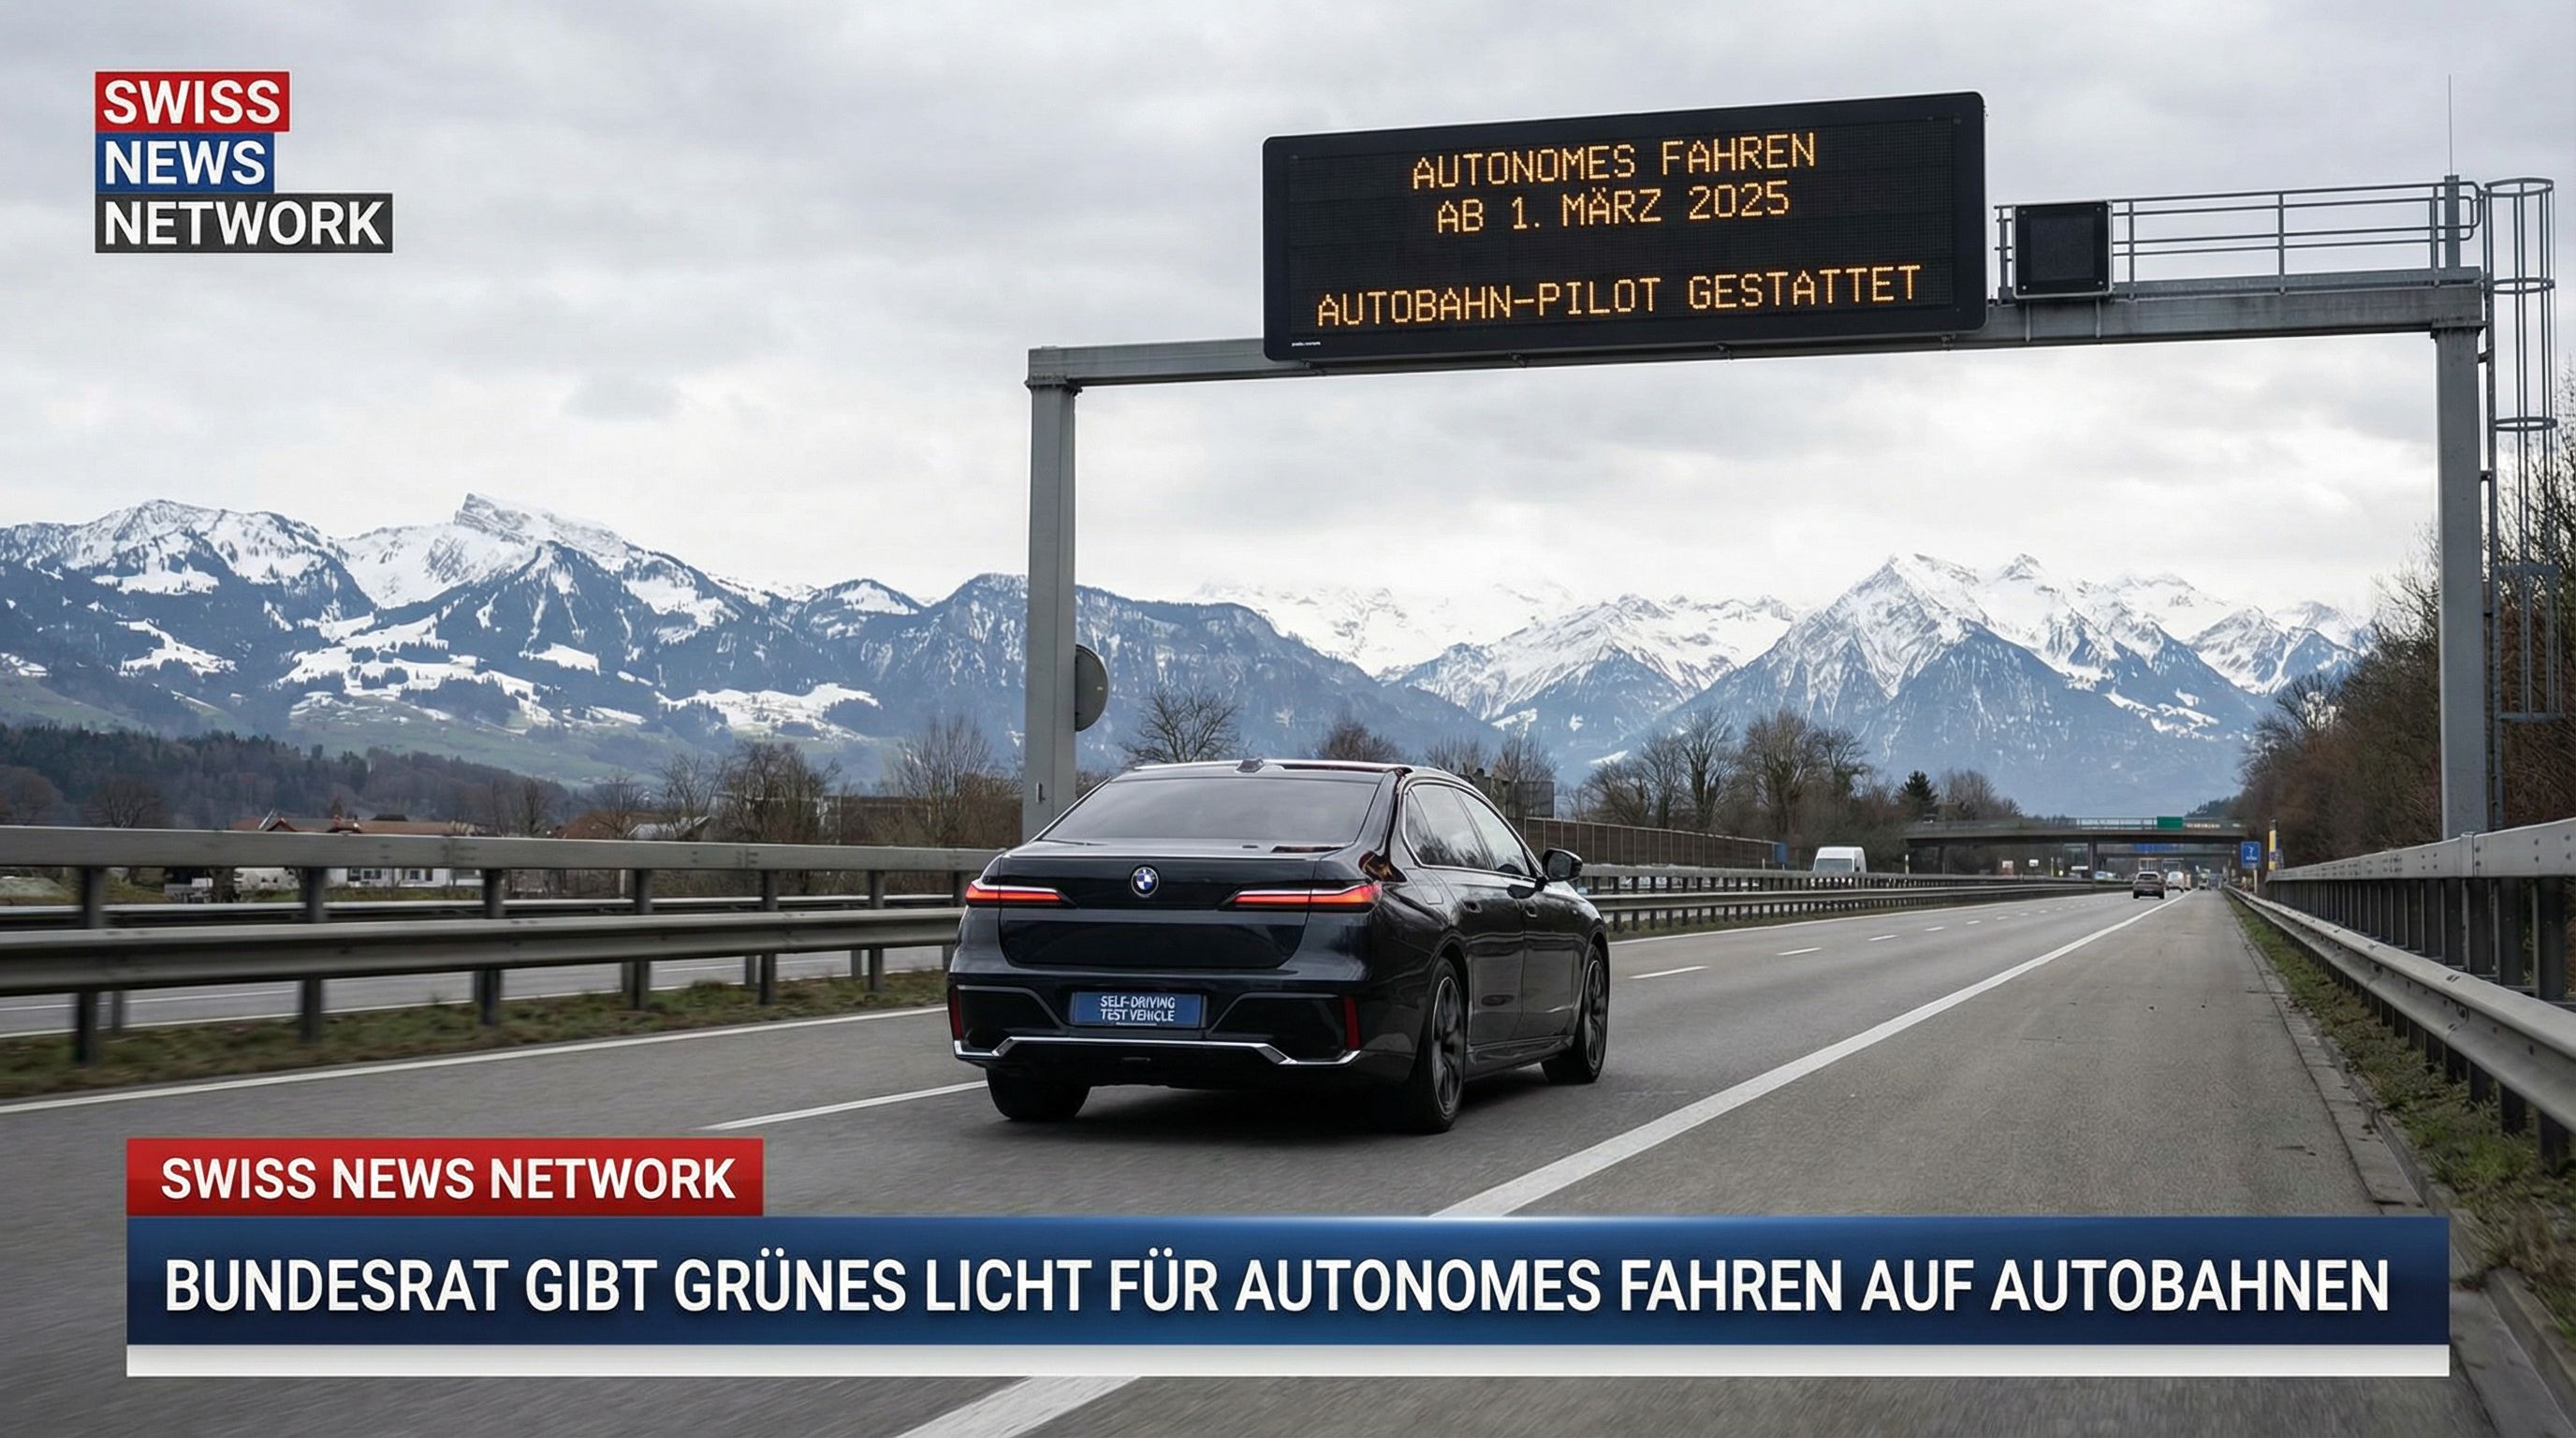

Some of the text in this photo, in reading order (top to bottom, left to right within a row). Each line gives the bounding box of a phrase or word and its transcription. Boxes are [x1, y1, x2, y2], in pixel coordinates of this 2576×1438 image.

[1412, 131, 1817, 190] AUTONOMES FAHREN
[1437, 180, 1791, 233] AB 1. MÄRZ 2025
[1317, 264, 1923, 328] AUTOBAHN-PILOT GESTATTET
[1100, 995, 1176, 1009] SELF-DRIVING
[1101, 1008, 1175, 1022] TEST VEHICLE
